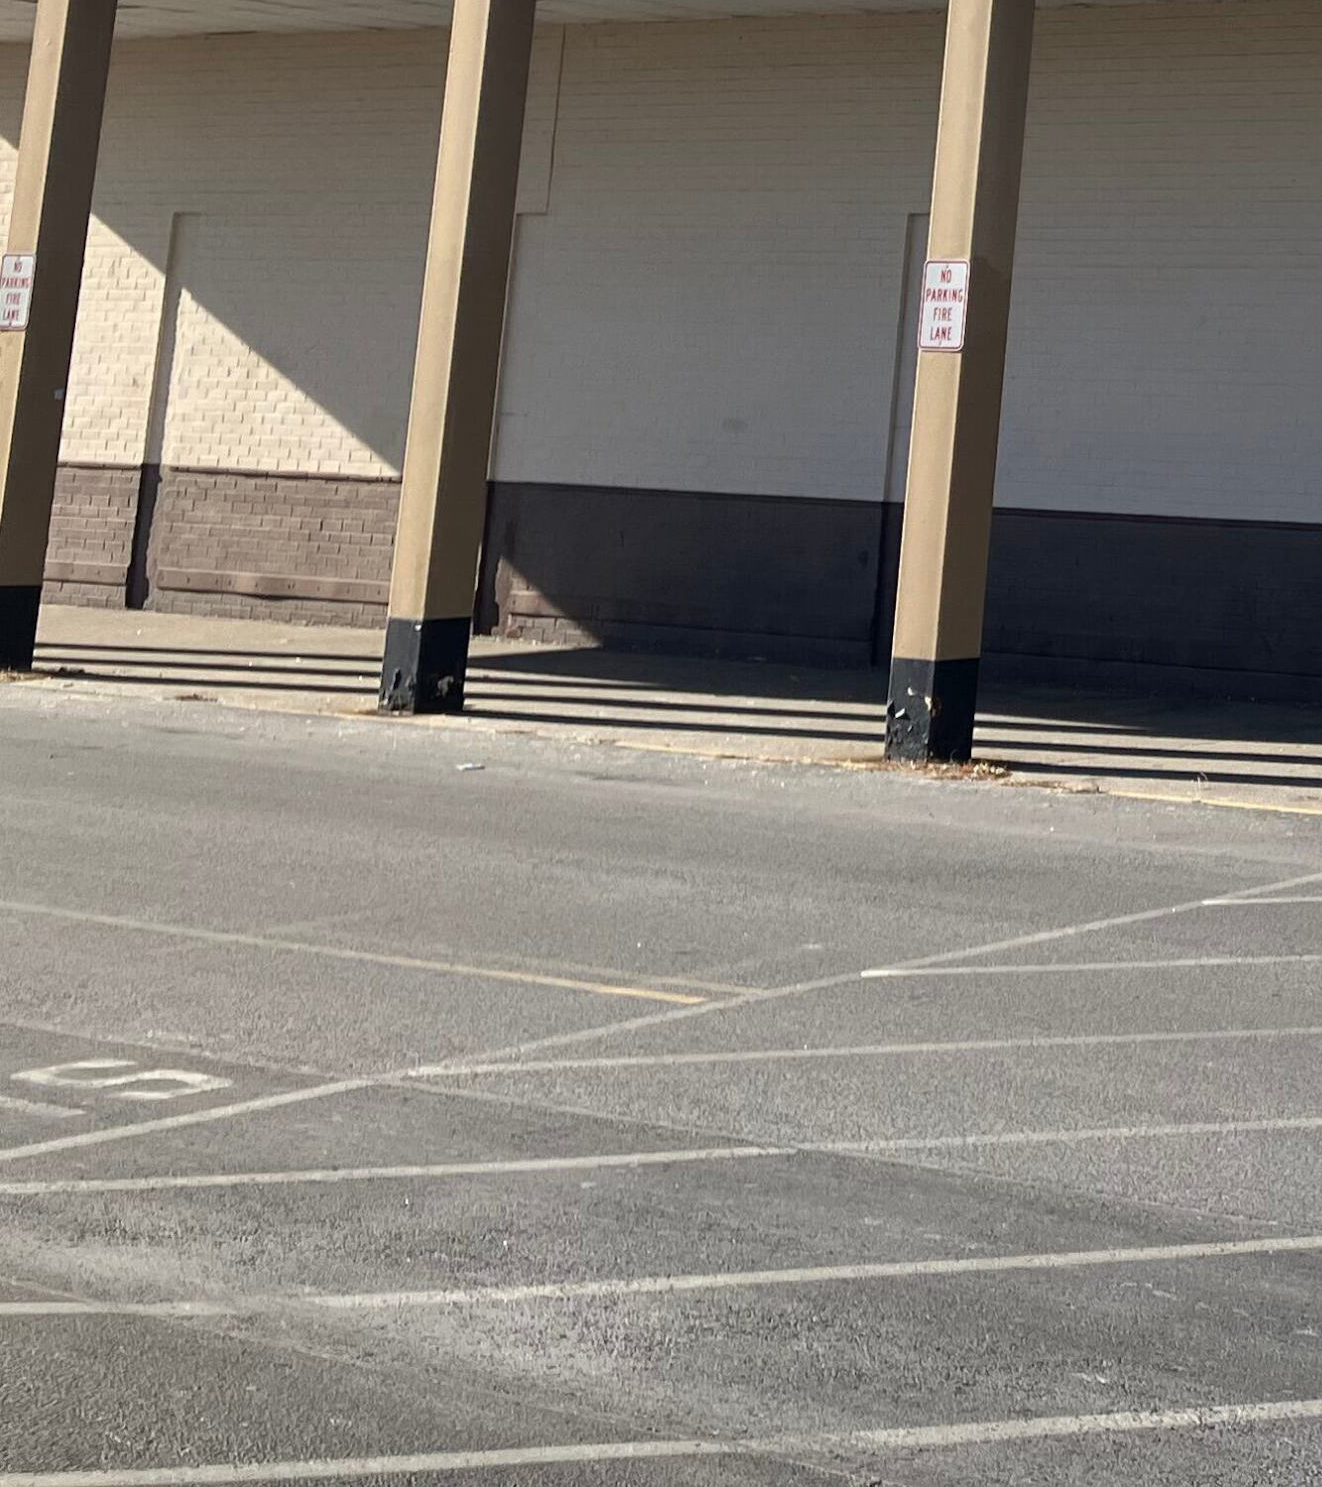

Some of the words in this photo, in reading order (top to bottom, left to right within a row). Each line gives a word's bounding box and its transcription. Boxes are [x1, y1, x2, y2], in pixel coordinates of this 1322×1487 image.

[940, 269, 952, 283] NO
[925, 288, 963, 303] PARKING
[933, 307, 952, 321] FIRE
[930, 326, 952, 341] LANE
